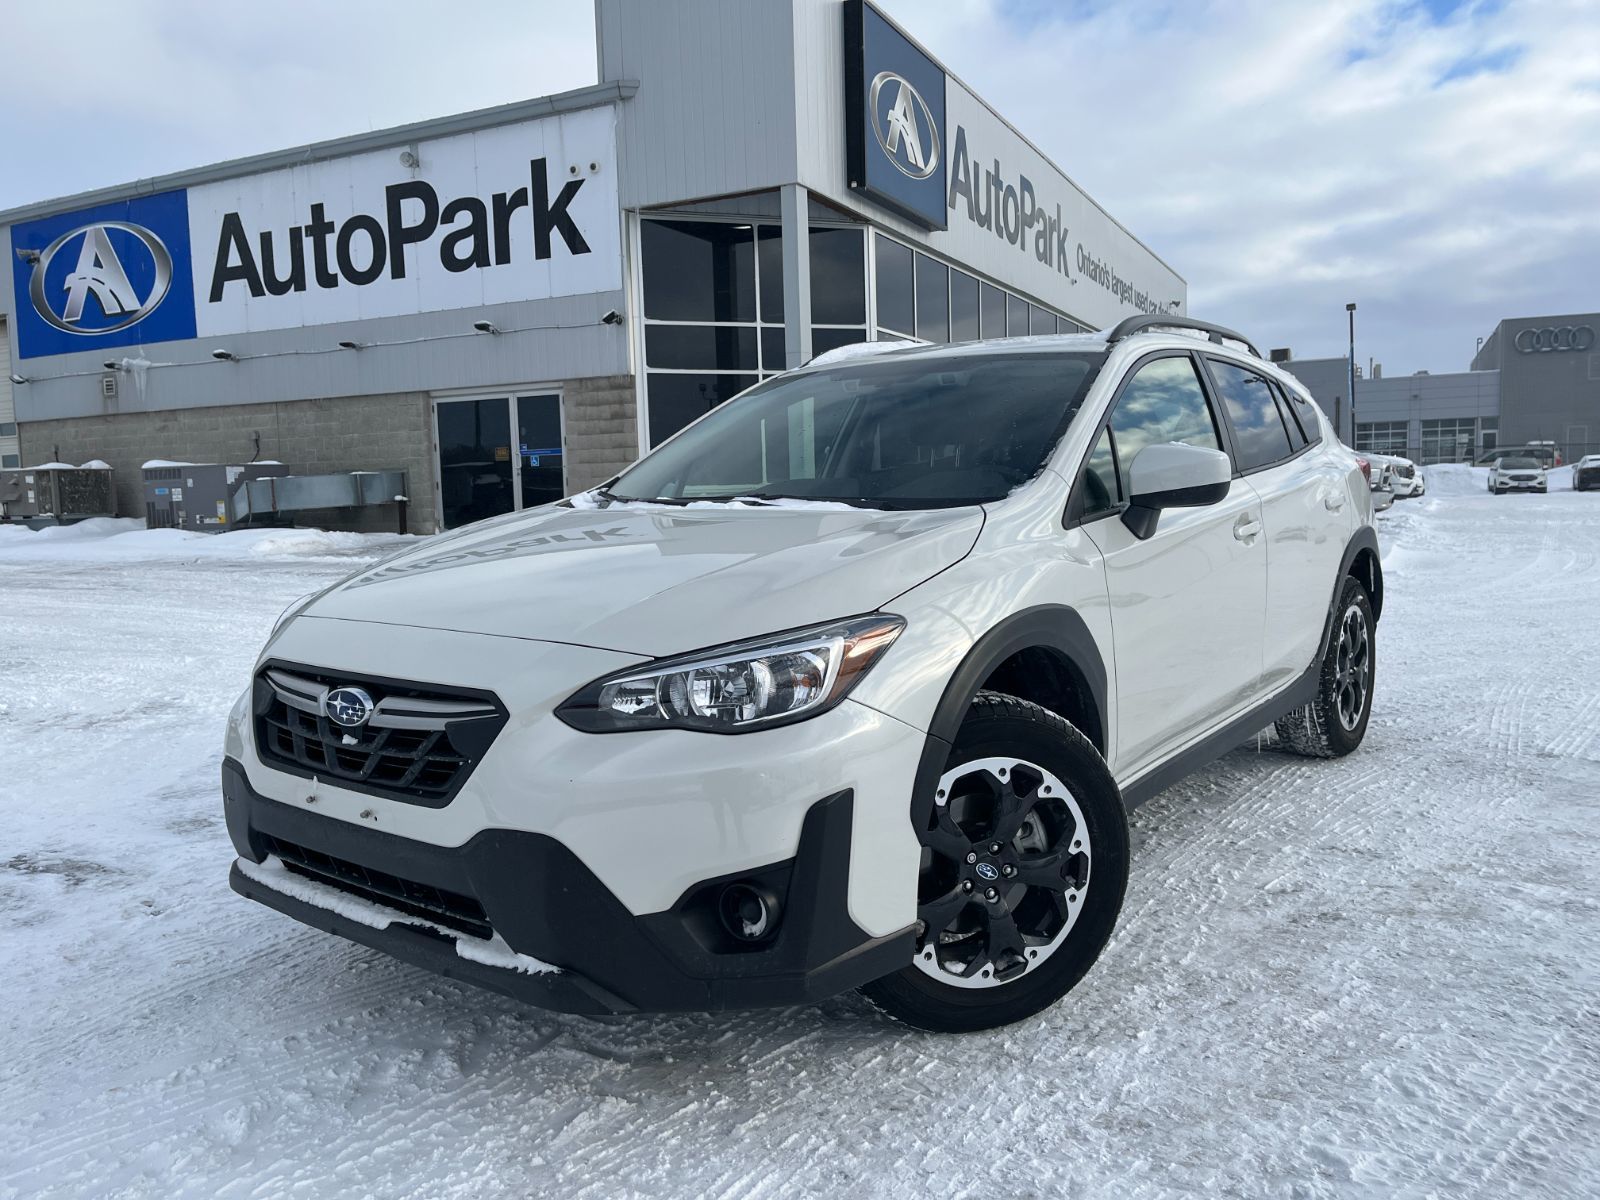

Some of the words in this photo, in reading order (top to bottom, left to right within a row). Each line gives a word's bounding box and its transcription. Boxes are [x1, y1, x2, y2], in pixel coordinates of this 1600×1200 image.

[209, 157, 592, 304] AutoPark
[948, 124, 1069, 278] AutoPark
[1077, 242, 1110, 290] Ontario's
[1111, 266, 1133, 304] largest
[1134, 289, 1148, 313] used
